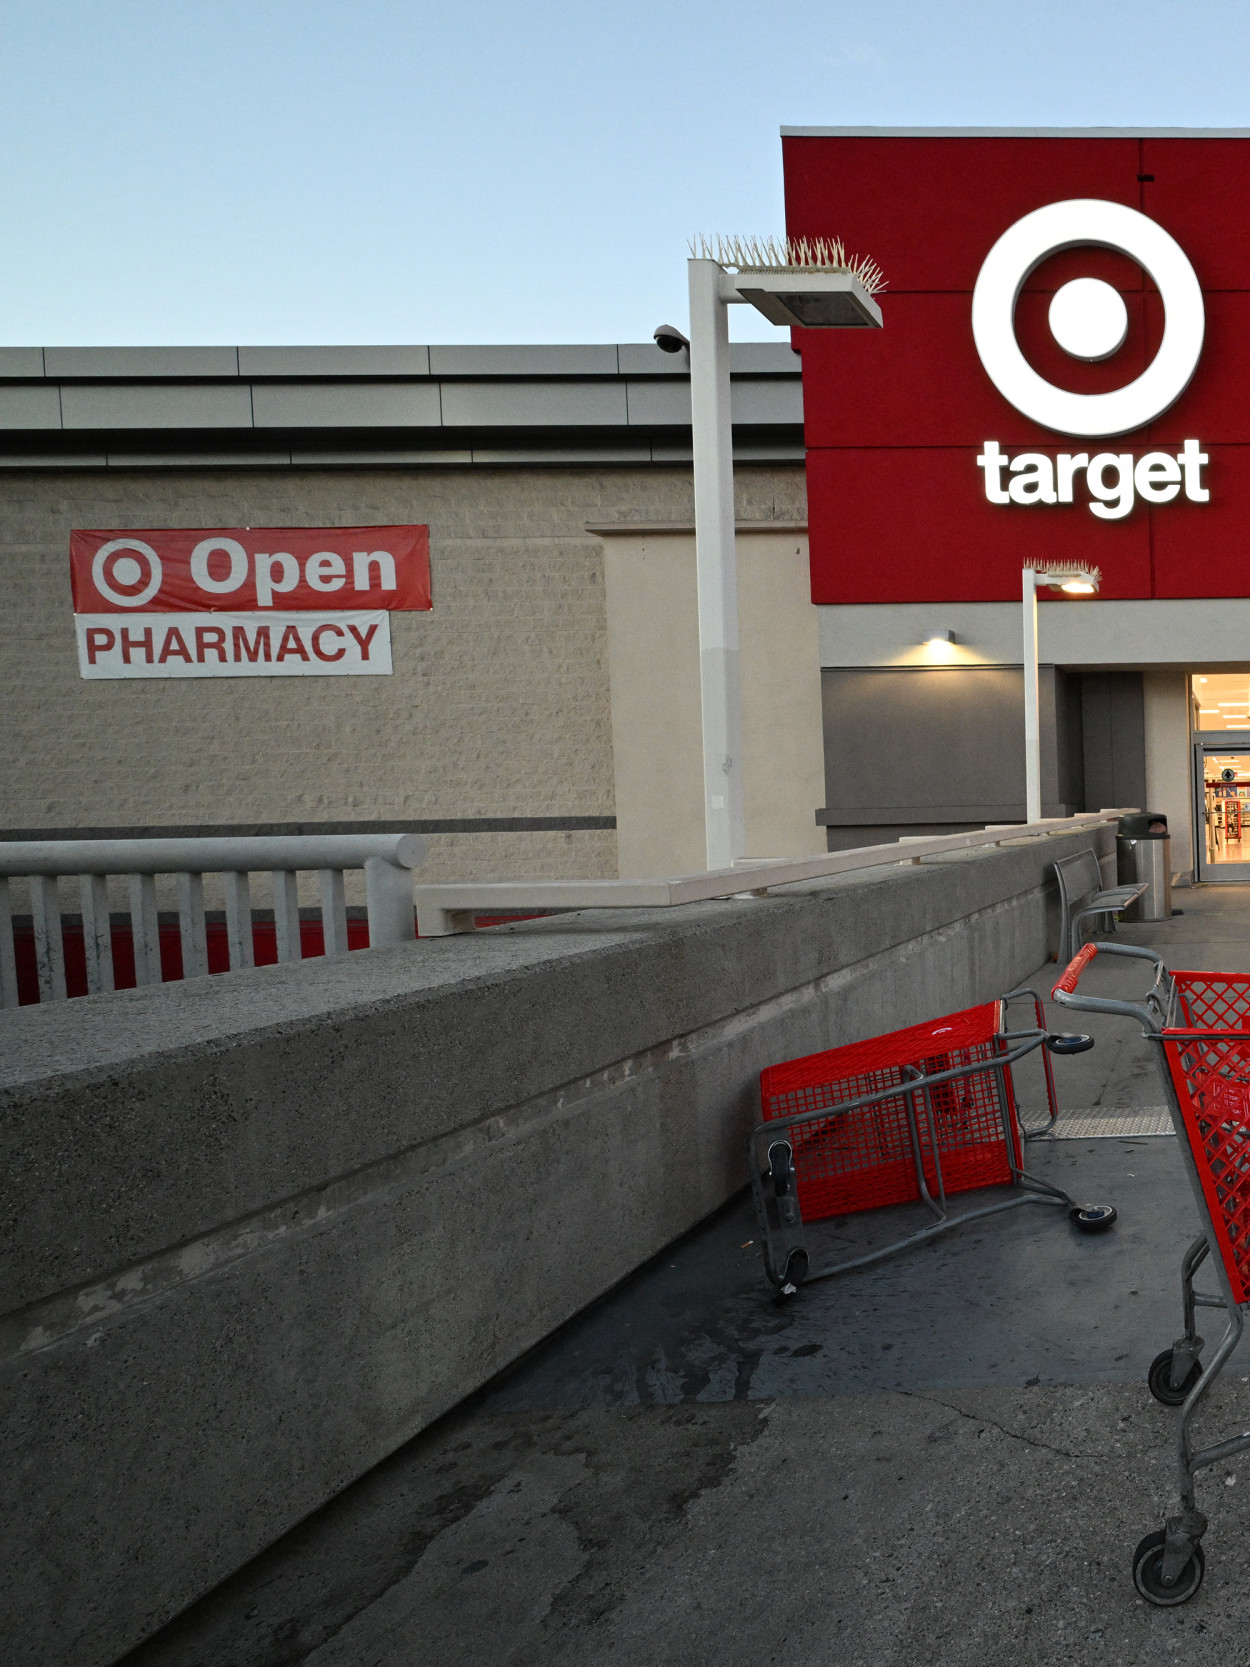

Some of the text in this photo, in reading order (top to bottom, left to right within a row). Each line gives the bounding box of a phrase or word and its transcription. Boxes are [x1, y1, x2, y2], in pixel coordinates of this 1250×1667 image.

[977, 440, 1209, 519] target
[190, 537, 397, 607] Open
[86, 624, 379, 665] PHARMACY
